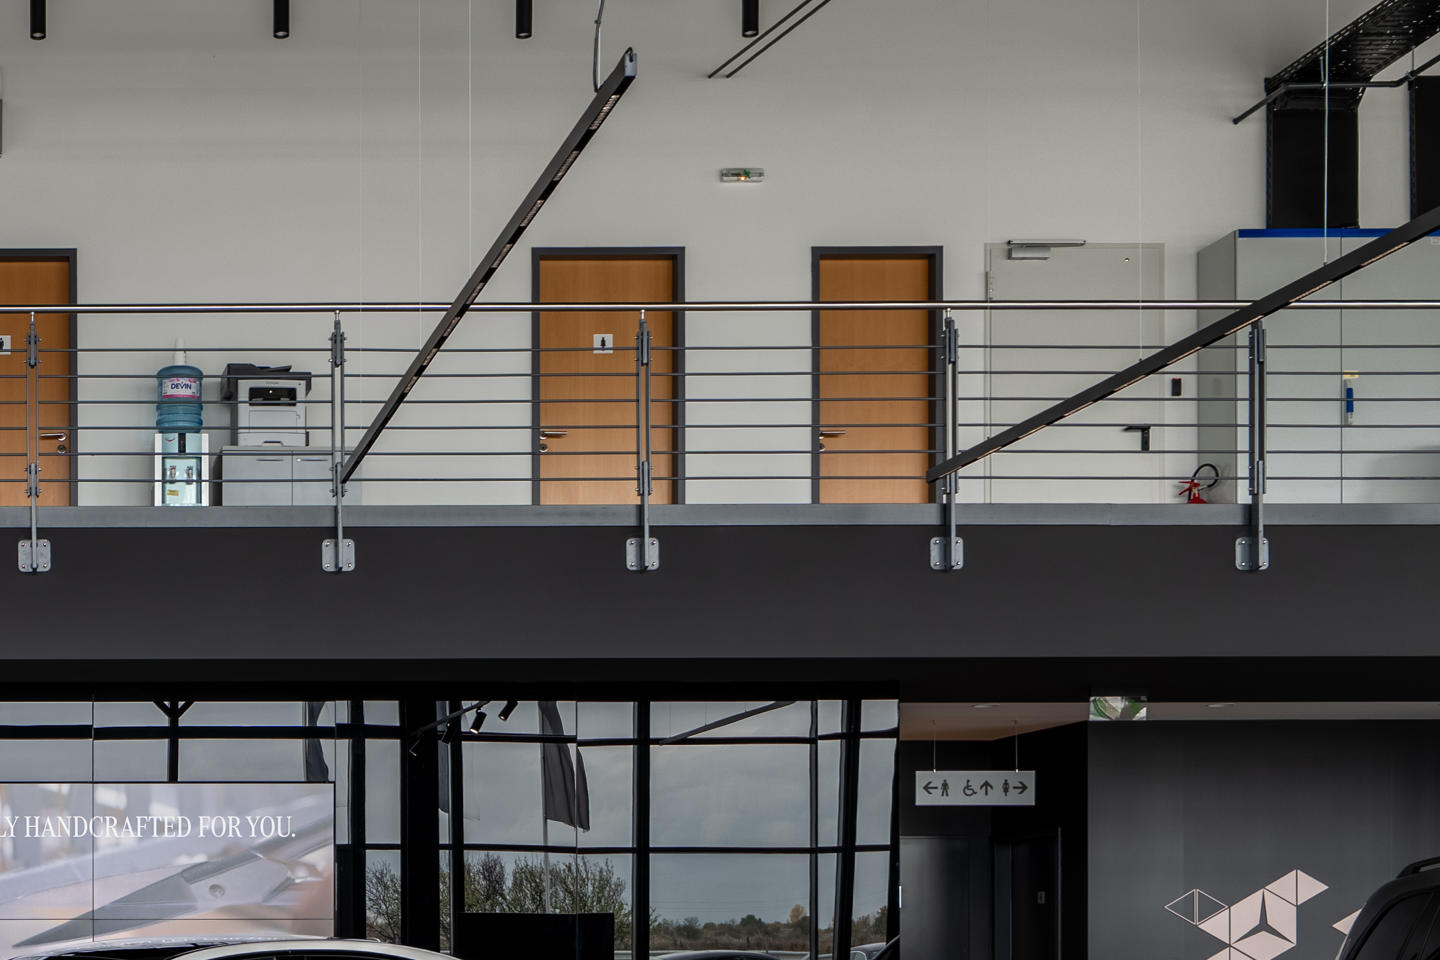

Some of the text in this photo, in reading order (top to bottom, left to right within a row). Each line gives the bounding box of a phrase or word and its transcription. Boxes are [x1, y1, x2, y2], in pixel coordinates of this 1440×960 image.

[170, 382, 192, 391] DEVIN
[24, 815, 191, 838] HANDCRAFTED
[198, 815, 242, 838] FOR
[246, 815, 296, 838] YOU.
